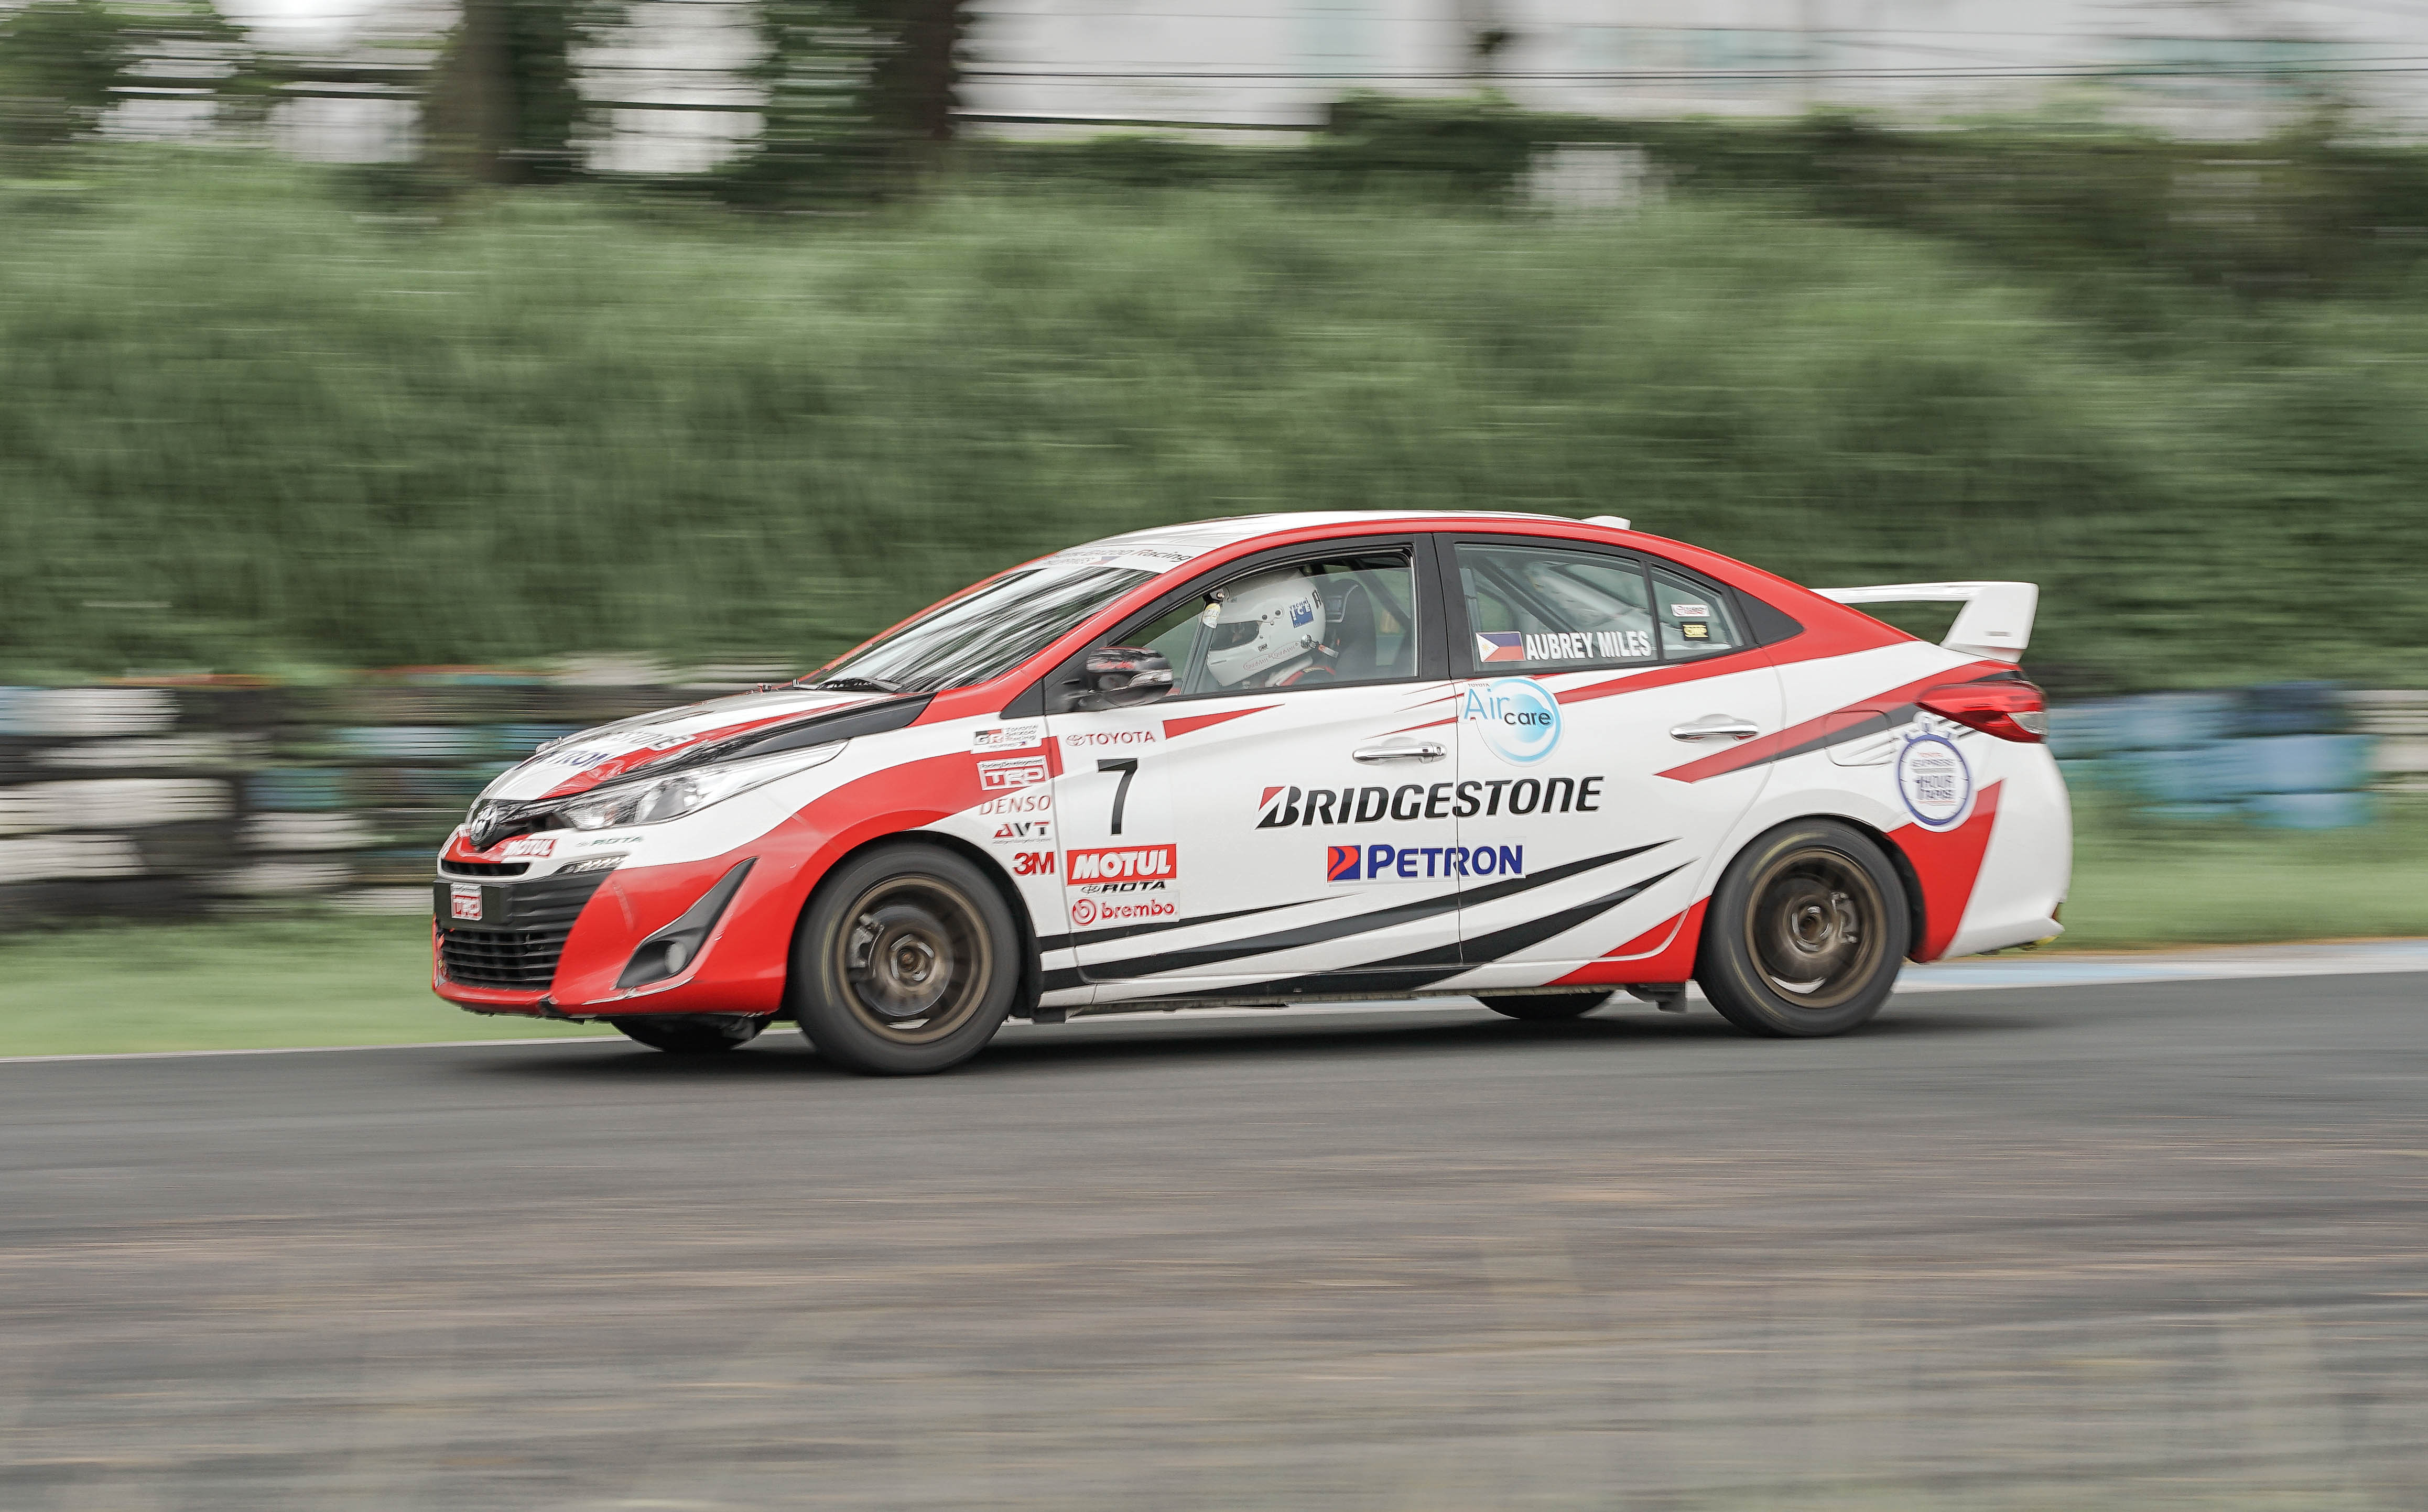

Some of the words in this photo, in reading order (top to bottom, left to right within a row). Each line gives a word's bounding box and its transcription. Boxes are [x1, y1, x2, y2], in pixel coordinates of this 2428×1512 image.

[1135, 549, 1194, 563] Racing
[1525, 632, 1592, 661] AUBREY
[1597, 630, 1652, 658] MILES
[1464, 688, 1510, 720] Air
[1504, 712, 1552, 725] care
[1085, 731, 1156, 746] TOYOTA
[984, 767, 1045, 786] TRD
[979, 795, 1052, 815] DENSO
[1097, 758, 1138, 835] 7
[1255, 776, 1605, 830] BRIDGESTONE
[993, 821, 1050, 839] AVT
[501, 839, 556, 857] MOTUL
[591, 836, 643, 846] ROTA
[1014, 851, 1055, 875] 3M
[1071, 850, 1172, 880] MOTUL
[1367, 844, 1523, 880] PETRON
[1101, 881, 1166, 894] ROTA
[1101, 899, 1175, 919] brembo
